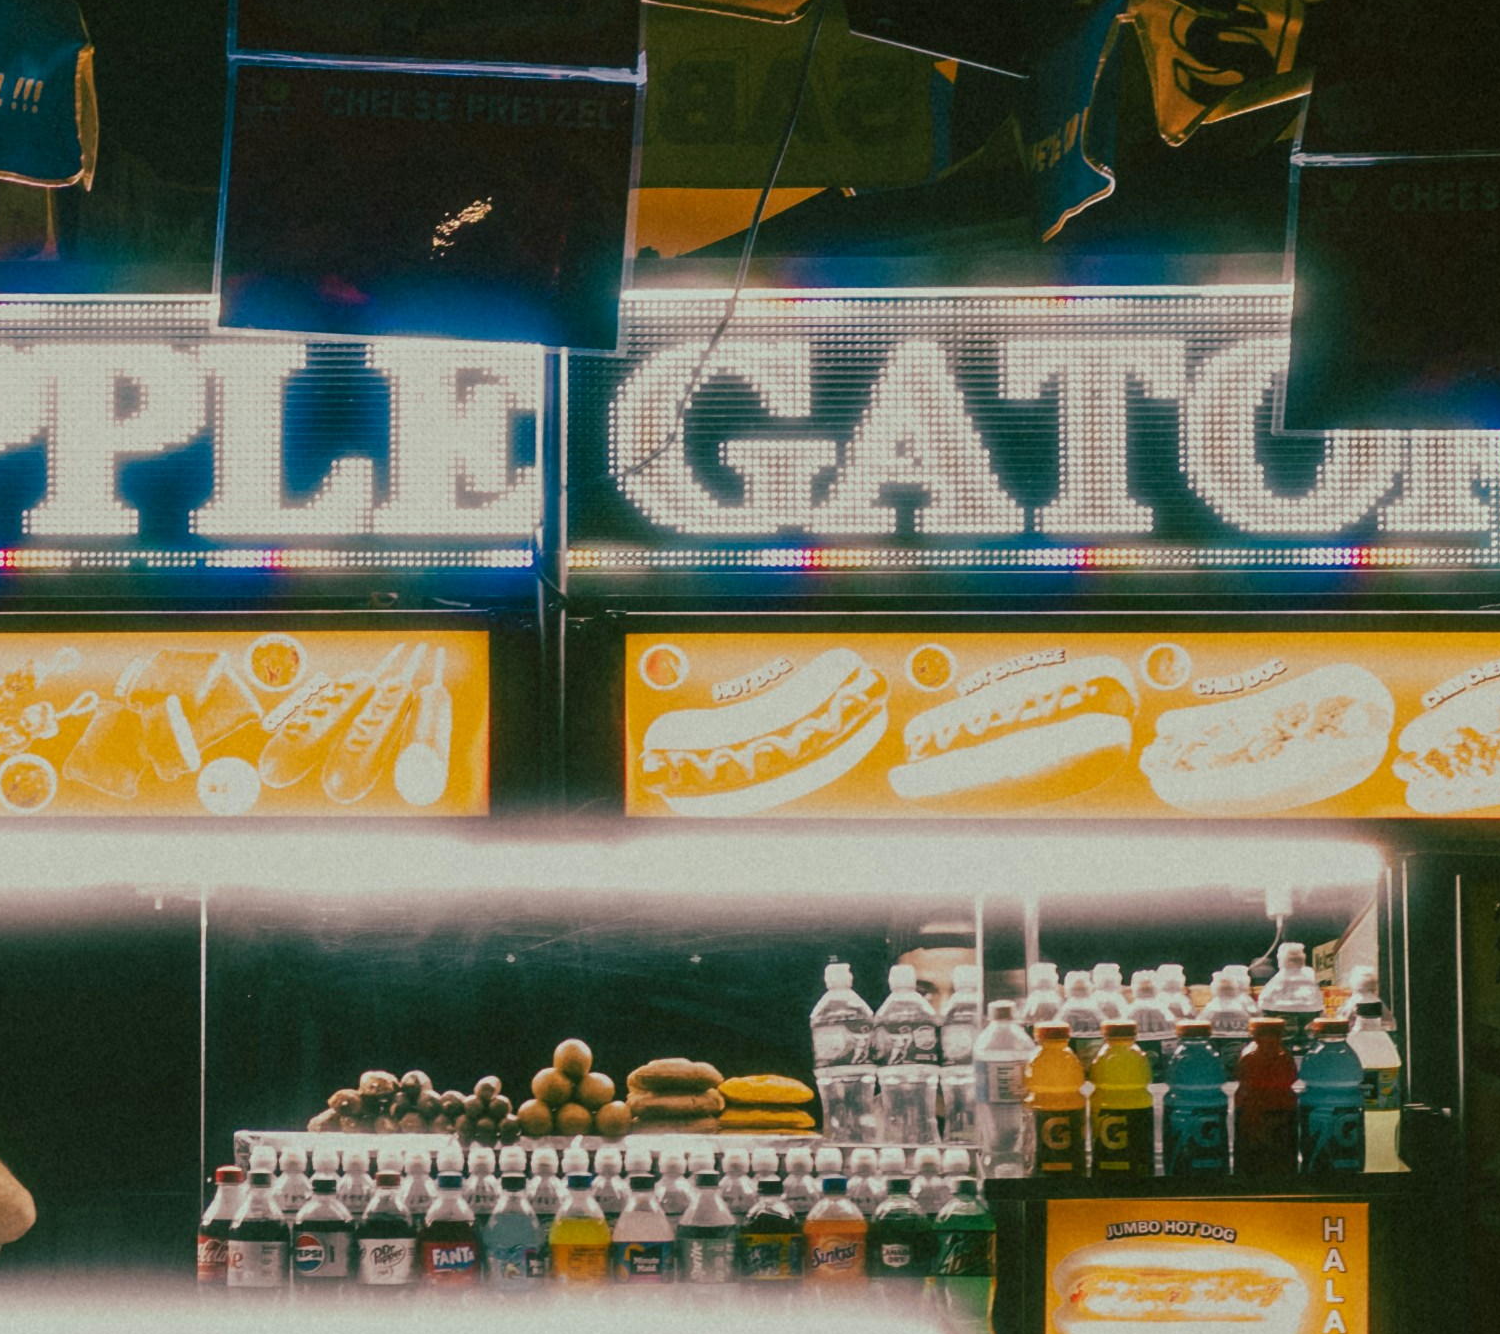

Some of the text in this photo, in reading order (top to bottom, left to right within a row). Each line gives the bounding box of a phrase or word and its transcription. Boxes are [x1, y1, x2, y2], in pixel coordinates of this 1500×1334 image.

[11, 77, 43, 114] !!!
[1042, 1117, 1071, 1150] G
[1100, 1116, 1128, 1150] G
[1105, 1220, 1236, 1242] JUMBO HOT DOG
